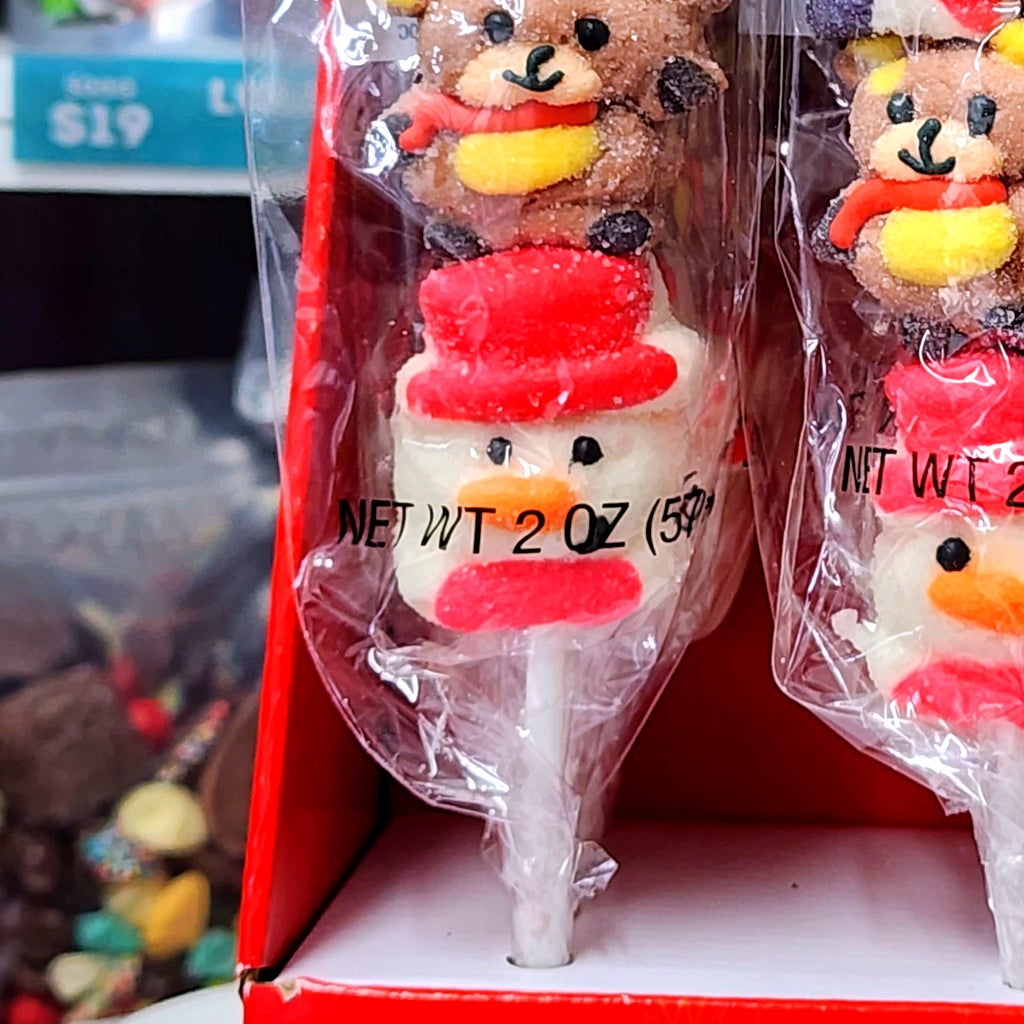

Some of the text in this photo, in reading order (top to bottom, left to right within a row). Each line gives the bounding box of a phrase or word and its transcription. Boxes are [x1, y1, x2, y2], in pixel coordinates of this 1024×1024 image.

[49, 99, 153, 150] $19
[841, 444, 898, 496] NET
[912, 451, 989, 503] WT
[337, 498, 414, 550] NET
[420, 503, 496, 555] WT
[512, 509, 546, 555] 2
[564, 502, 631, 555] OZ
